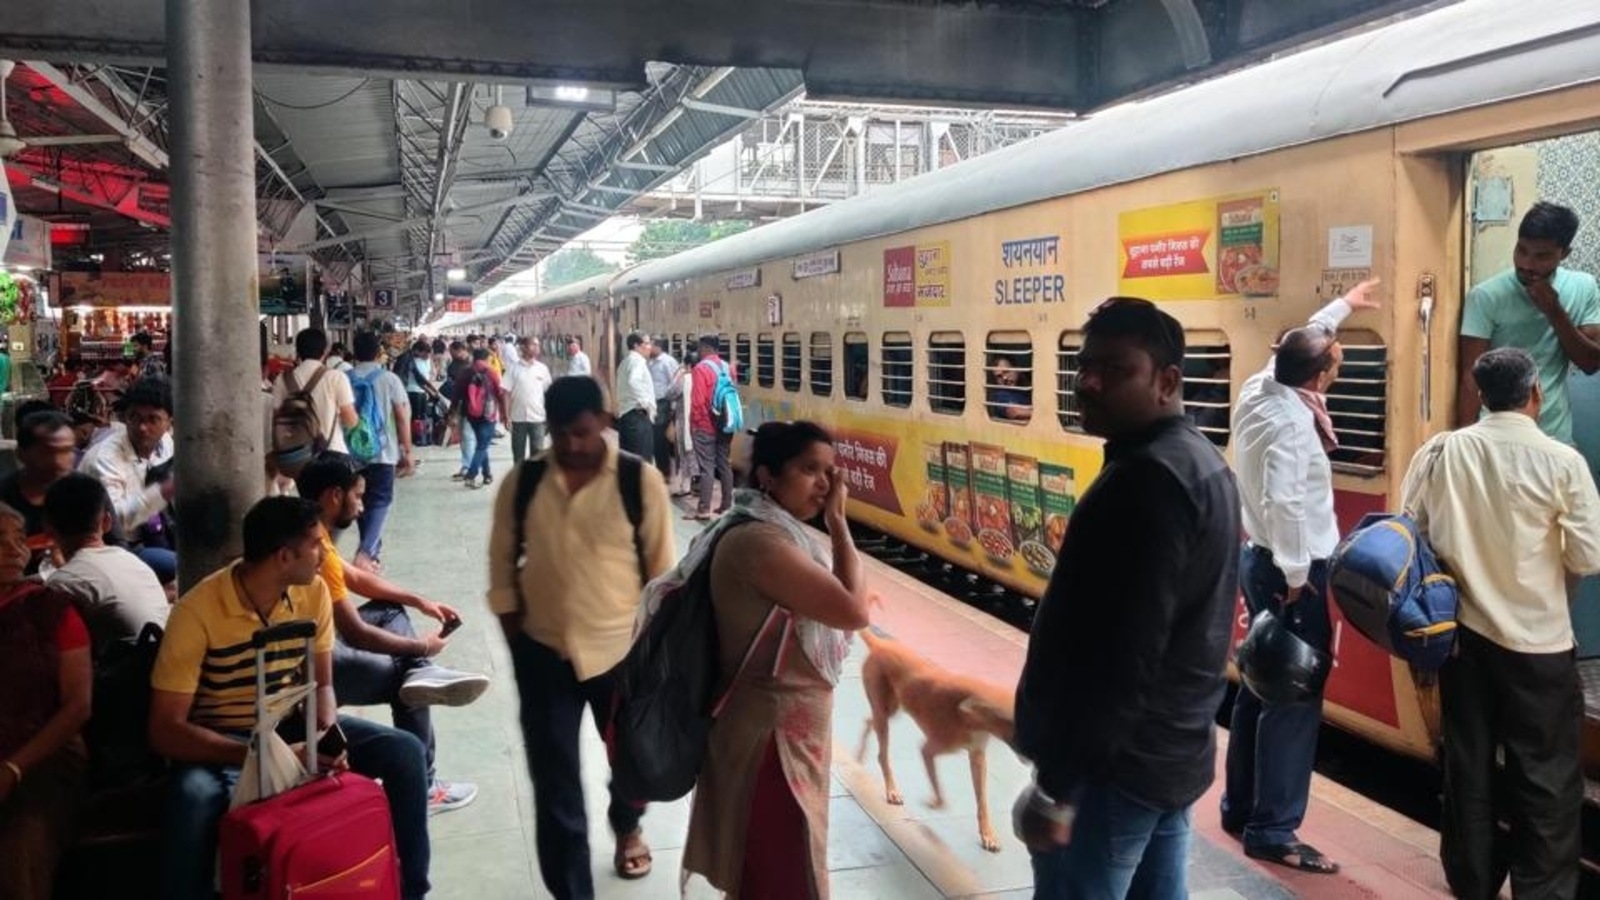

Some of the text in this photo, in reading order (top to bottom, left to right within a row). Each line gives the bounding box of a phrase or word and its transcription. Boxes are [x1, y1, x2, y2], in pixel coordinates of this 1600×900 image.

[1002, 236, 1060, 268] शयनयान
[378, 291, 388, 306] 3
[995, 275, 1065, 305] SLEEPER
